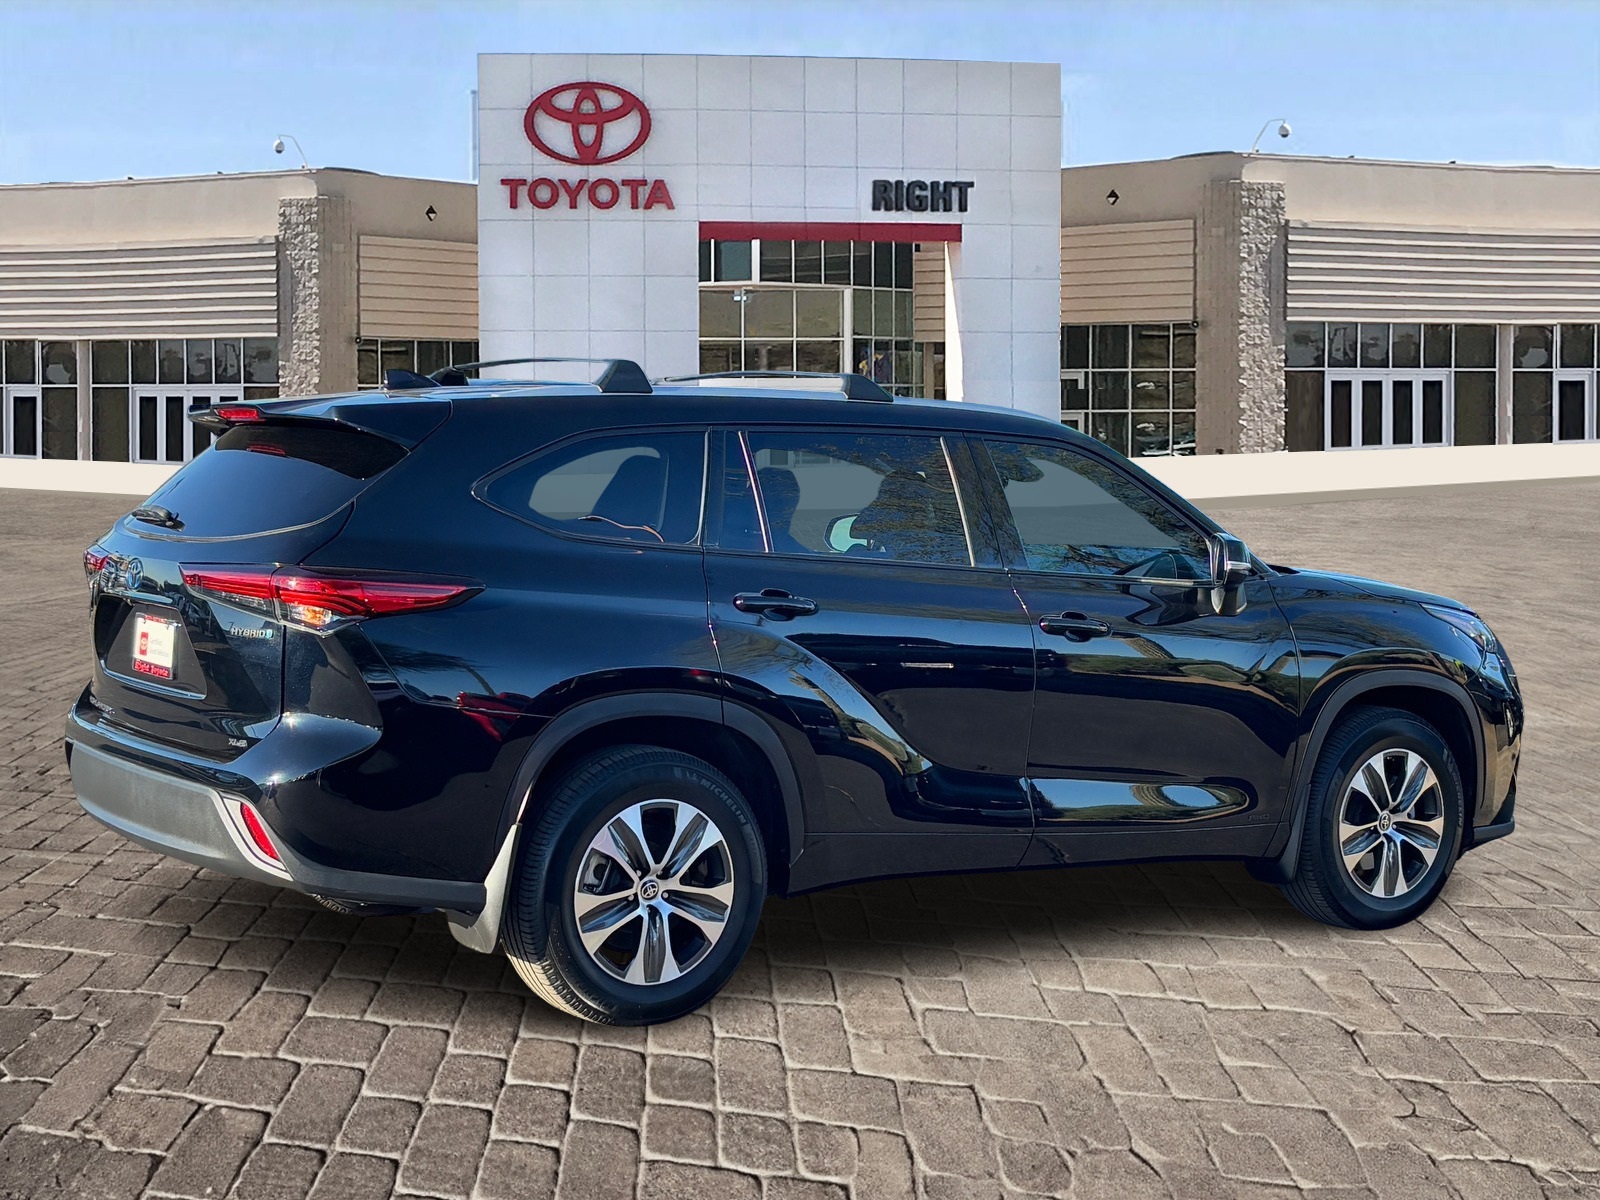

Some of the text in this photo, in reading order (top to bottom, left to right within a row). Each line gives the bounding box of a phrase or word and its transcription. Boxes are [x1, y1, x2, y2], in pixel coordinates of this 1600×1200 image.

[501, 178, 675, 210] TOYOTA
[871, 179, 975, 213] RIGHT
[230, 627, 266, 638] HYBRID
[700, 778, 748, 825] MICHELIN
